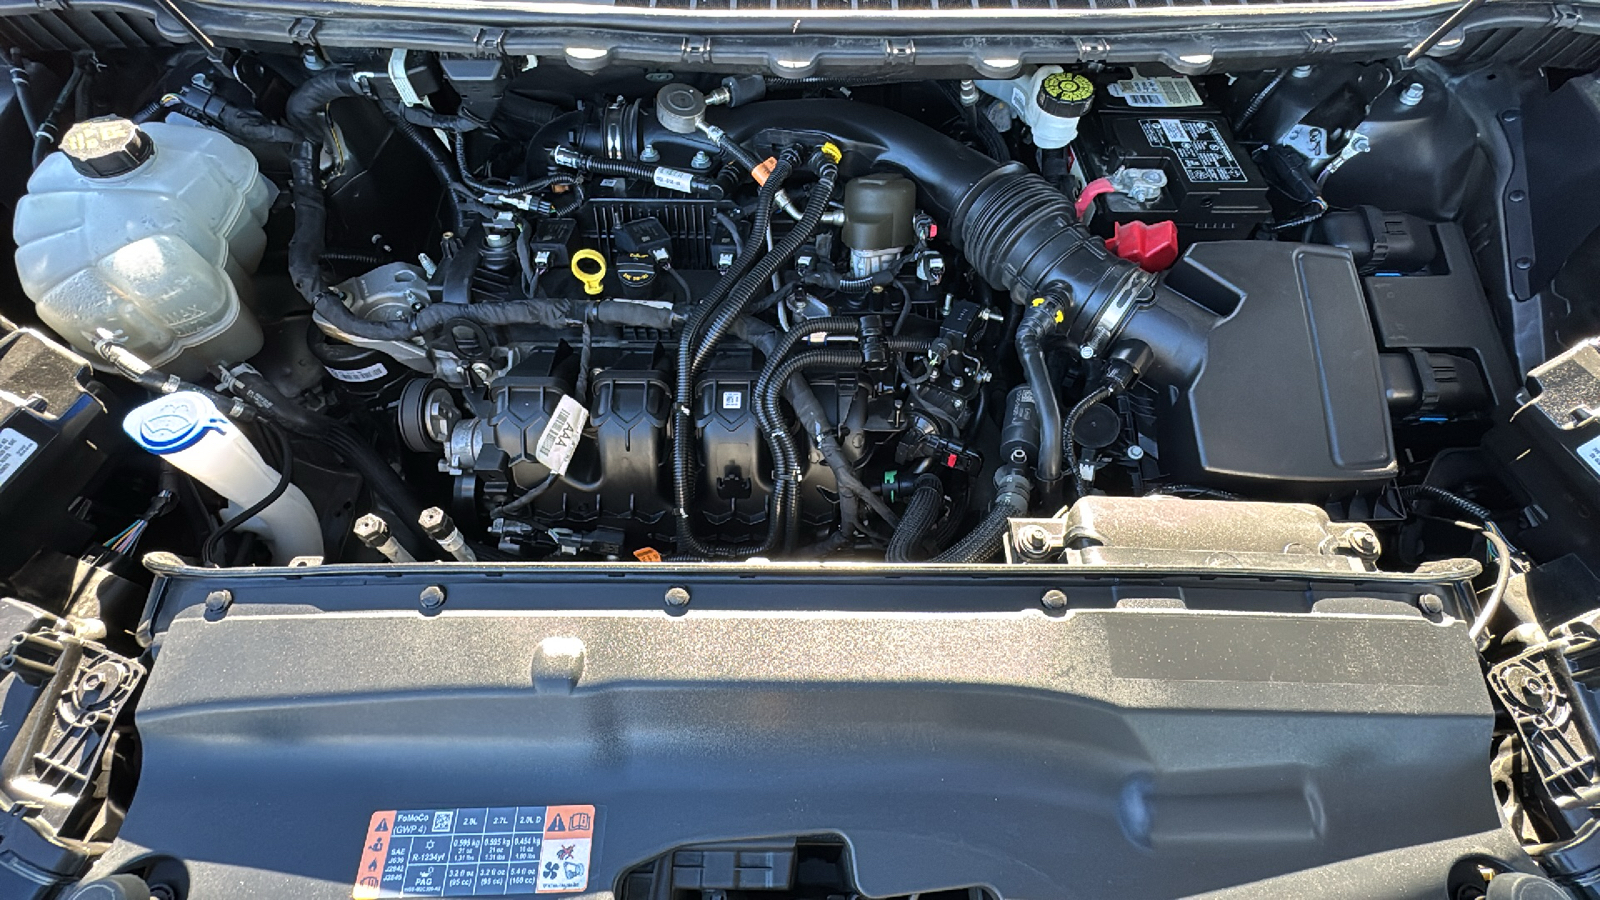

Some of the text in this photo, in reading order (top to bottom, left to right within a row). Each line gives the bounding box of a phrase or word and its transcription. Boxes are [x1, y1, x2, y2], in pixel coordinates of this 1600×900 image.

[555, 422, 573, 447] AAA
[394, 826, 427, 834] (GWP 4)
[472, 838, 480, 848] kg
[503, 838, 510, 847] kg
[533, 837, 540, 846] kg
[412, 853, 445, 862] R-1234yf
